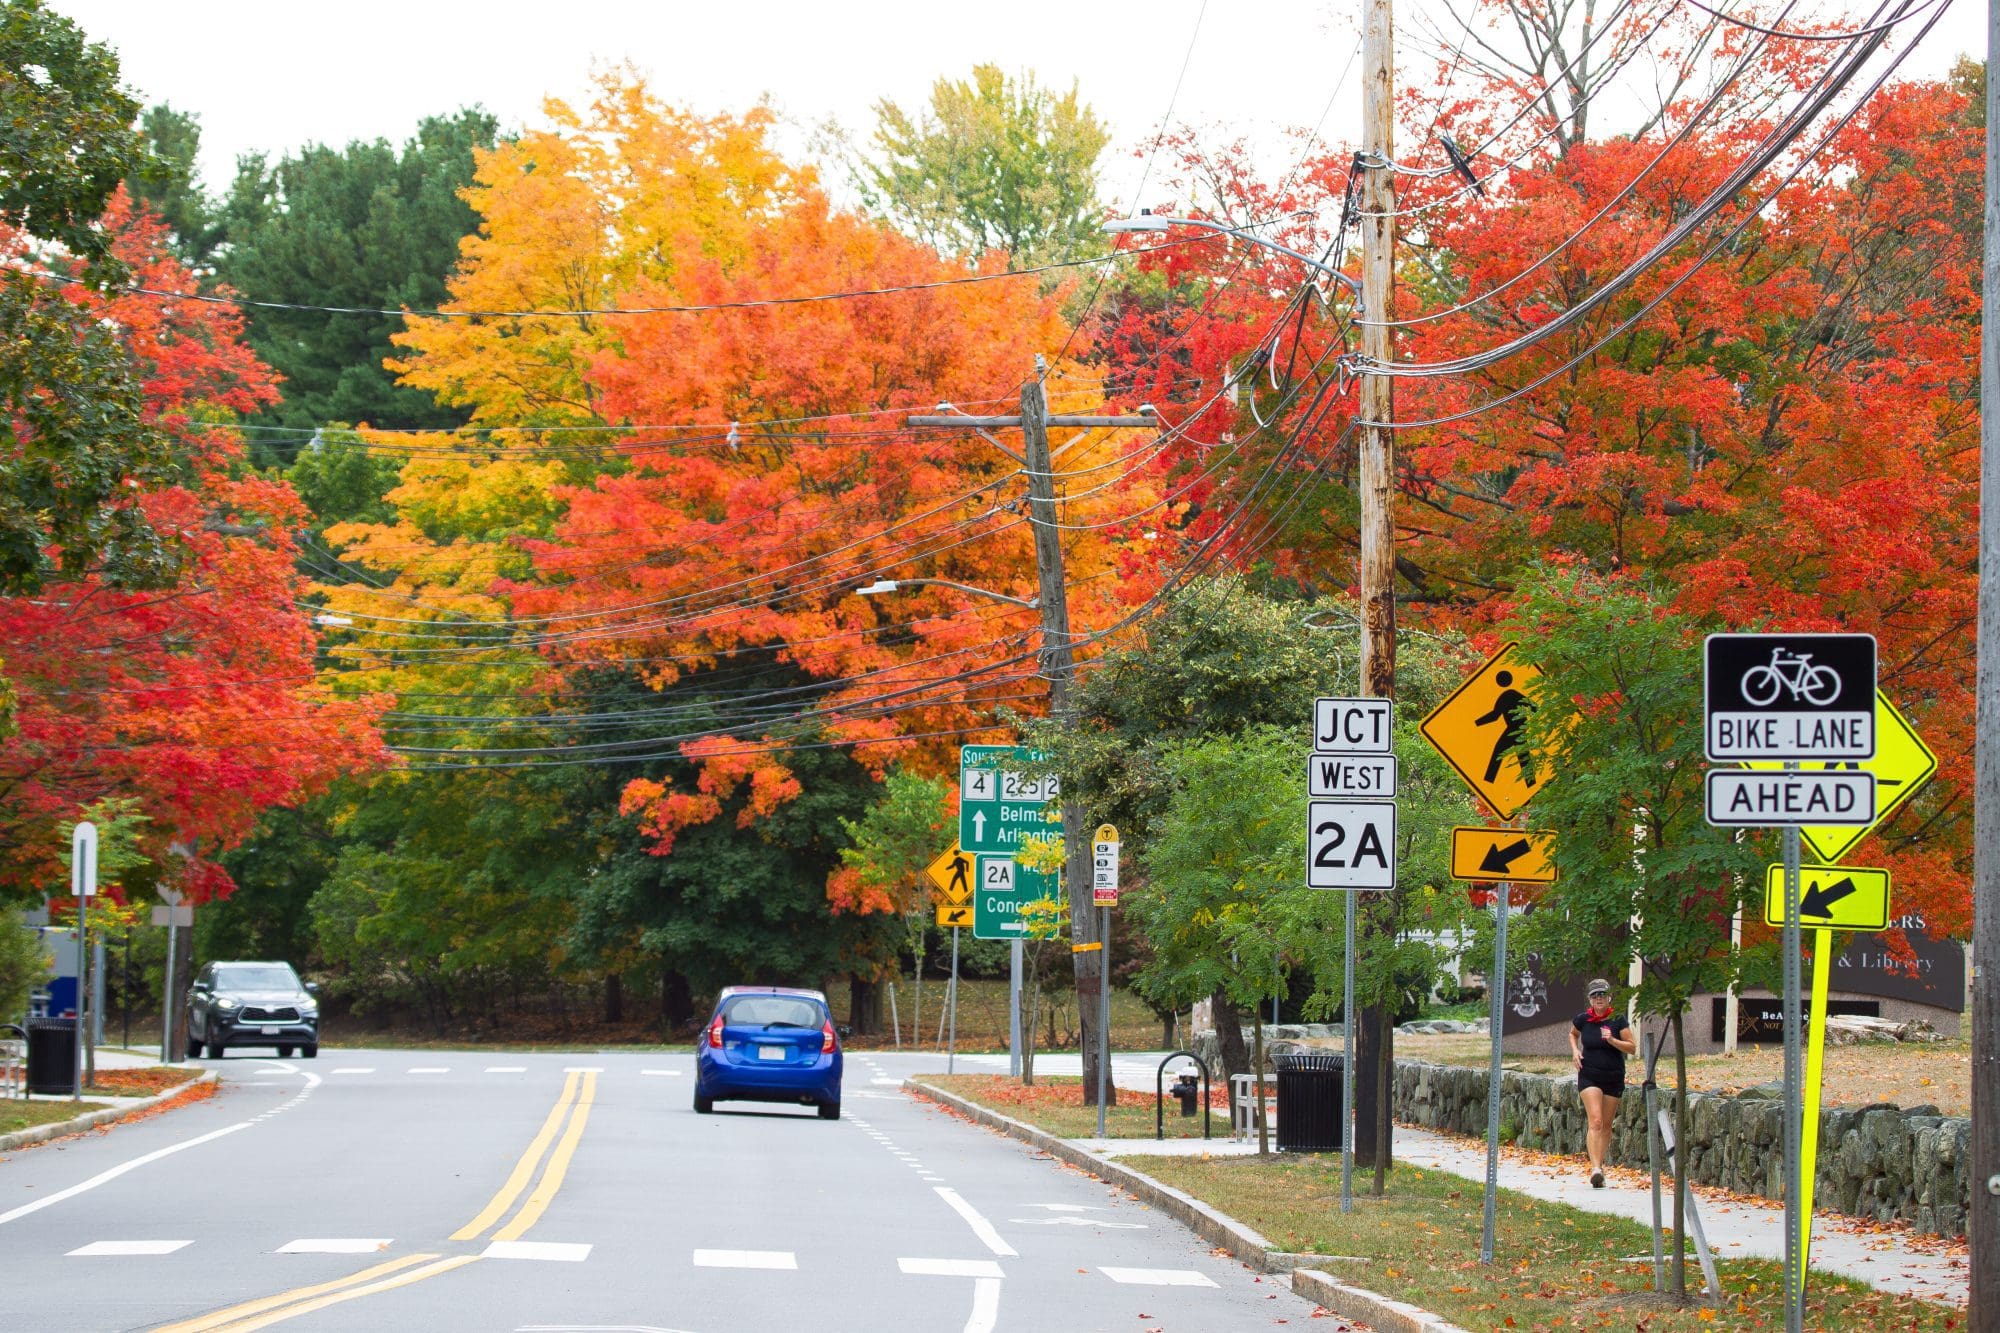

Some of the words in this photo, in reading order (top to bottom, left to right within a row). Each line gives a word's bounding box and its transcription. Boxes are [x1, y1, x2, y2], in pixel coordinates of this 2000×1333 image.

[1319, 708, 1386, 744] JCT
[1718, 718, 1779, 749] BIKE
[1796, 718, 1864, 749] LANE
[972, 776, 986, 794] 4
[1047, 777, 1059, 795] 2
[1320, 761, 1385, 790] WEST
[1729, 782, 1856, 813] AHEAD
[1000, 805, 1055, 823] Belm
[1314, 820, 1389, 869] 2A
[987, 865, 1010, 884] 2A
[986, 896, 1033, 914] Conc
[1838, 954, 1853, 968] &
[1861, 952, 1935, 973] Libry
